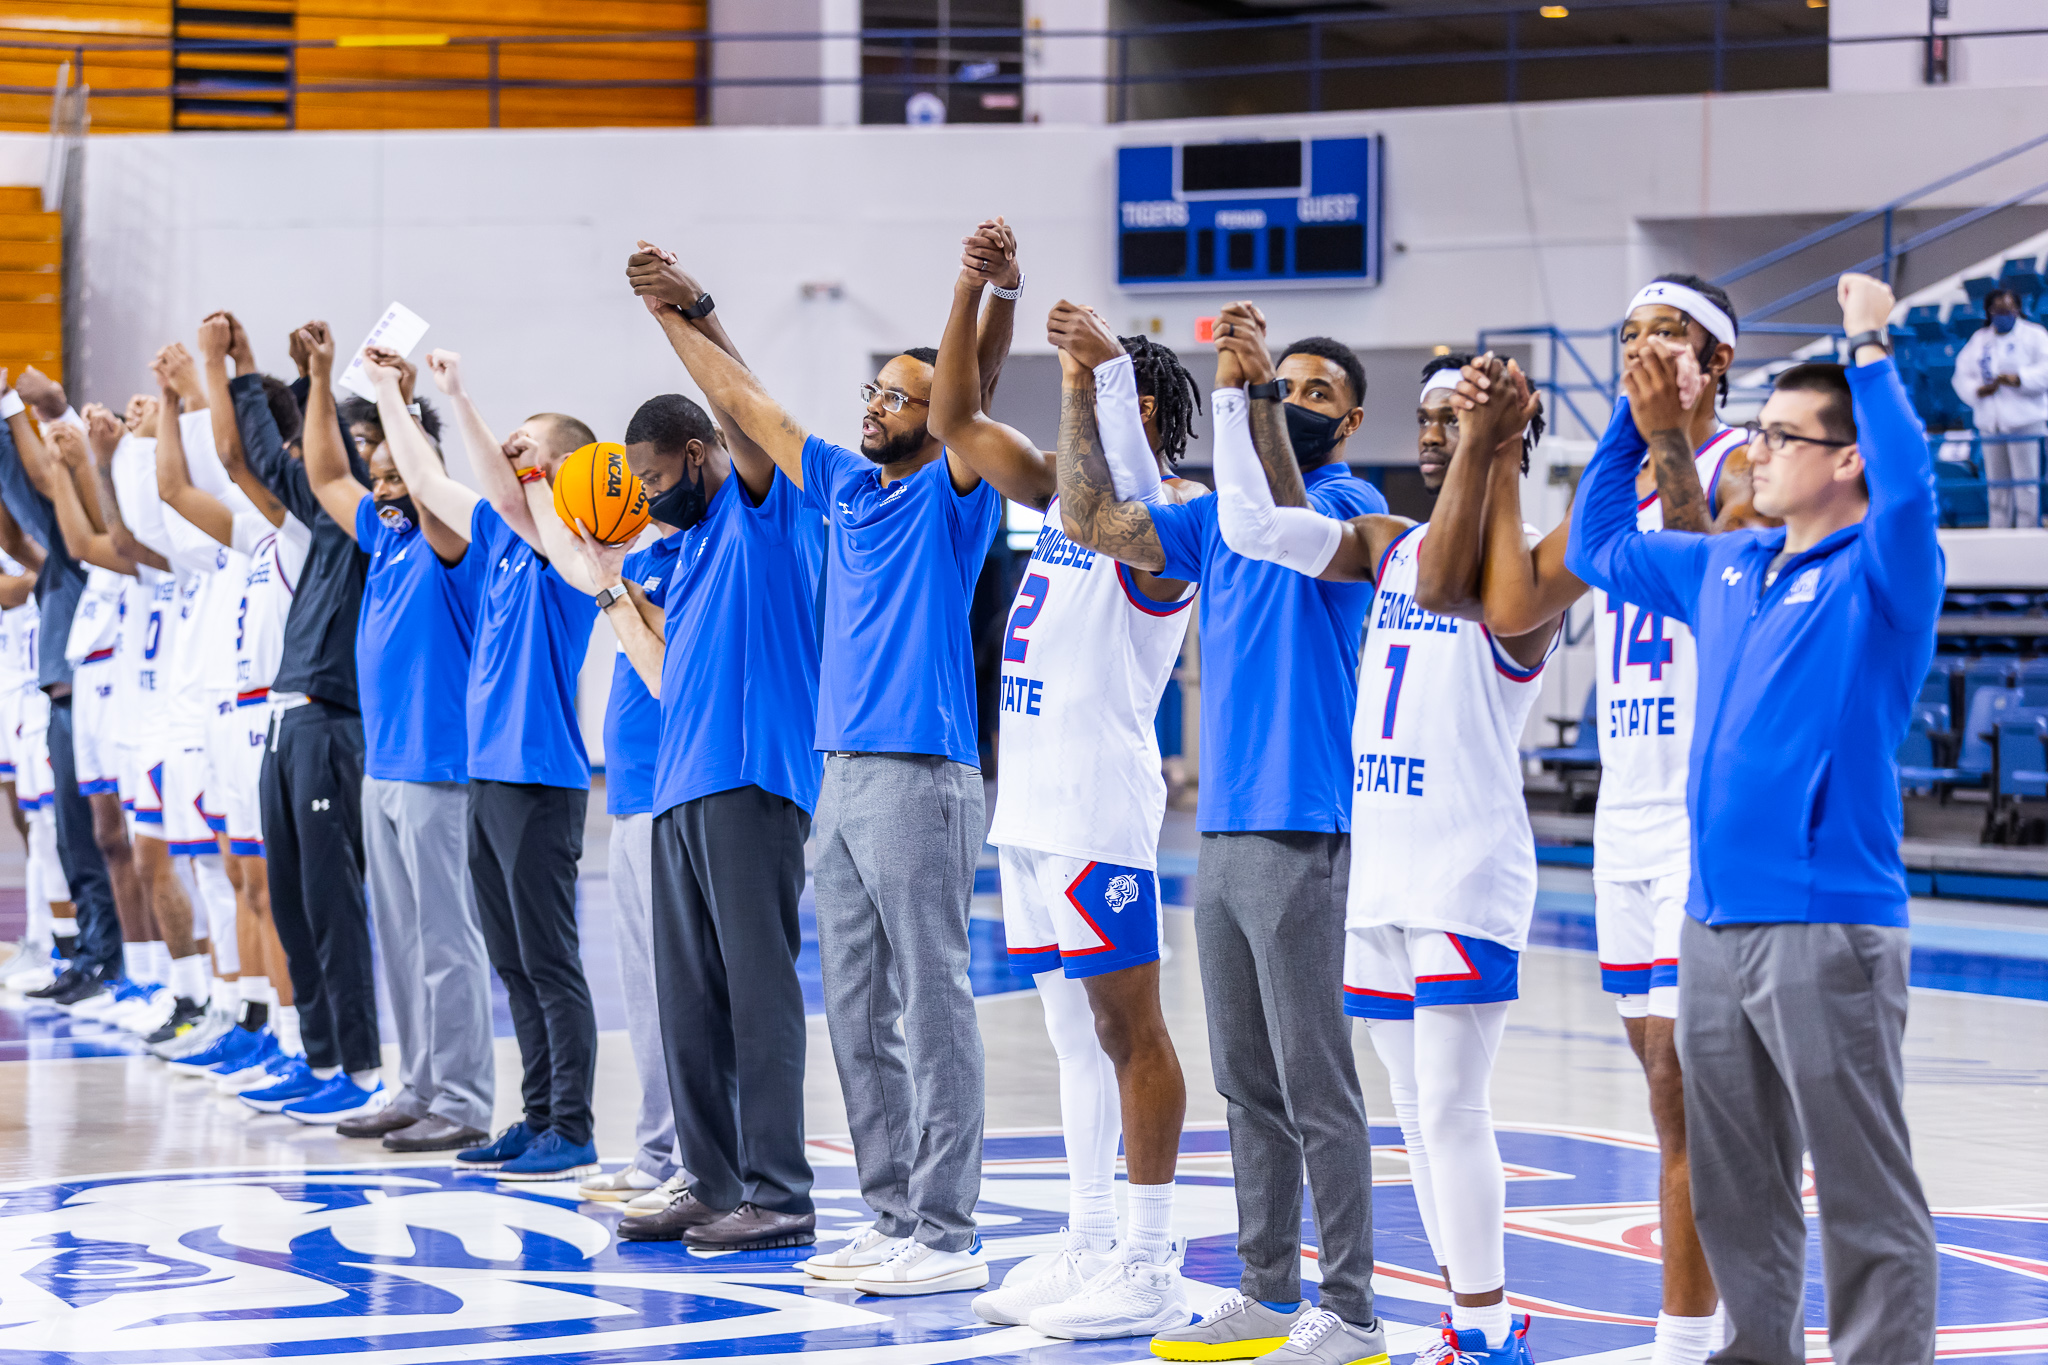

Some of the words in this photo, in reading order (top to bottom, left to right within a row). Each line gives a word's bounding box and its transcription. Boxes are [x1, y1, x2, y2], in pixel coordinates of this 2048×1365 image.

[1122, 201, 1189, 228] TIGERS
[1298, 193, 1359, 222] GUEST
[606, 452, 623, 497] NCAA
[1004, 573, 1050, 664] 2
[1606, 593, 1673, 684] 14
[1001, 675, 1044, 717] TATE
[1382, 644, 1411, 740] 1
[1610, 697, 1675, 738] STATE
[1356, 753, 1425, 797] STATE
